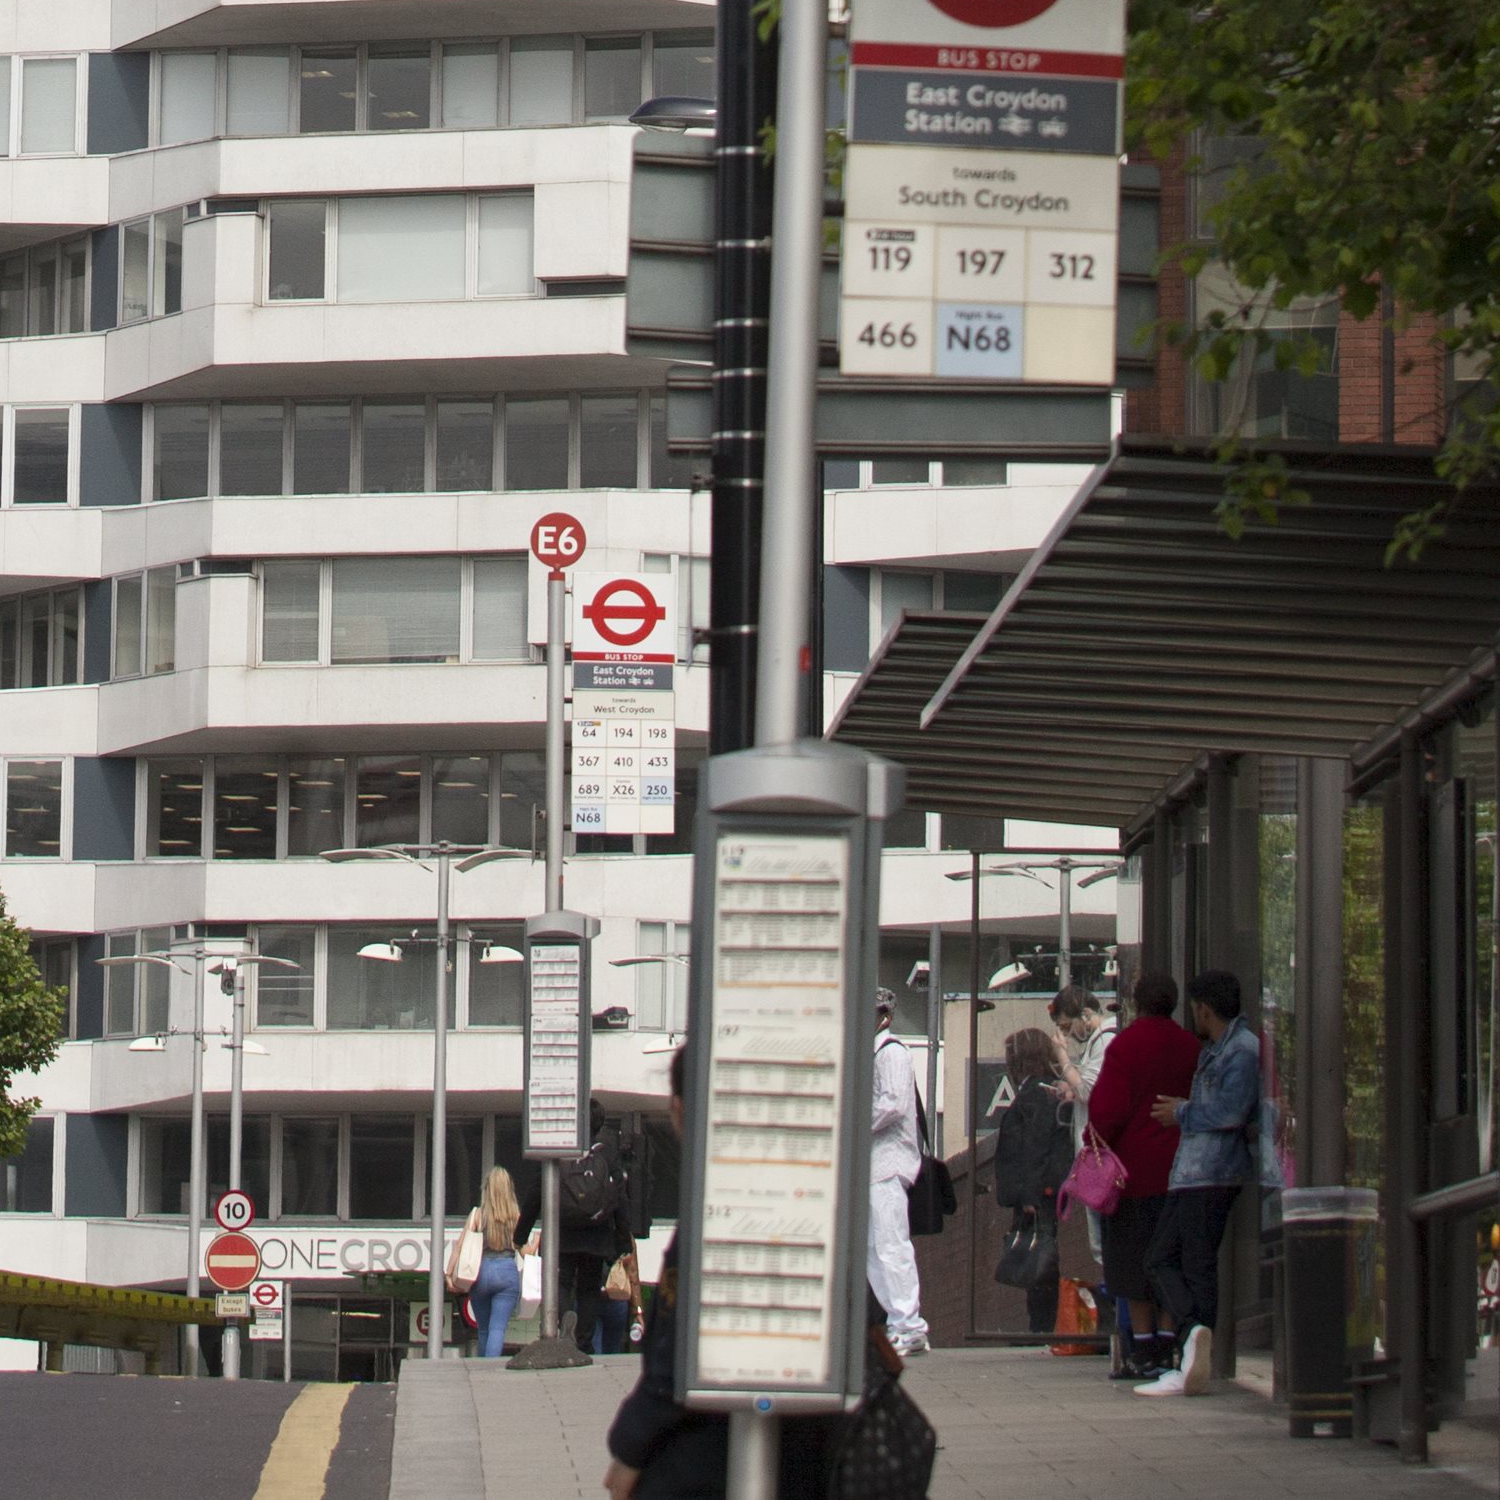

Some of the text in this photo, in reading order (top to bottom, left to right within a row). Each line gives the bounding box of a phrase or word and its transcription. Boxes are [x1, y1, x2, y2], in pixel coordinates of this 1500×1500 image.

[937, 49, 1041, 70] BUS STOP
[906, 82, 1068, 112] East Croydon
[904, 109, 992, 135] Station
[953, 167, 1017, 182] towards
[899, 186, 1069, 214] South Croydon
[868, 246, 912, 271] 119
[957, 249, 1005, 275] 197
[1049, 253, 1095, 280] 312
[858, 322, 917, 348] 466
[947, 326, 1011, 351] N68
[538, 525, 578, 555] E6
[593, 665, 654, 677] East Croydon
[593, 676, 626, 685] Station
[593, 705, 655, 715] West Croydon
[581, 727, 596, 737] 64
[614, 728, 633, 738] 194
[648, 728, 667, 738] 198
[578, 756, 599, 767] 367
[613, 756, 633, 767] 410
[647, 756, 668, 767] 433
[578, 784, 600, 795] 689
[612, 785, 635, 795] X26
[646, 785, 668, 795] 250
[576, 812, 601, 823] N68
[224, 1202, 246, 1220] 10
[221, 1297, 243, 1305] Except
